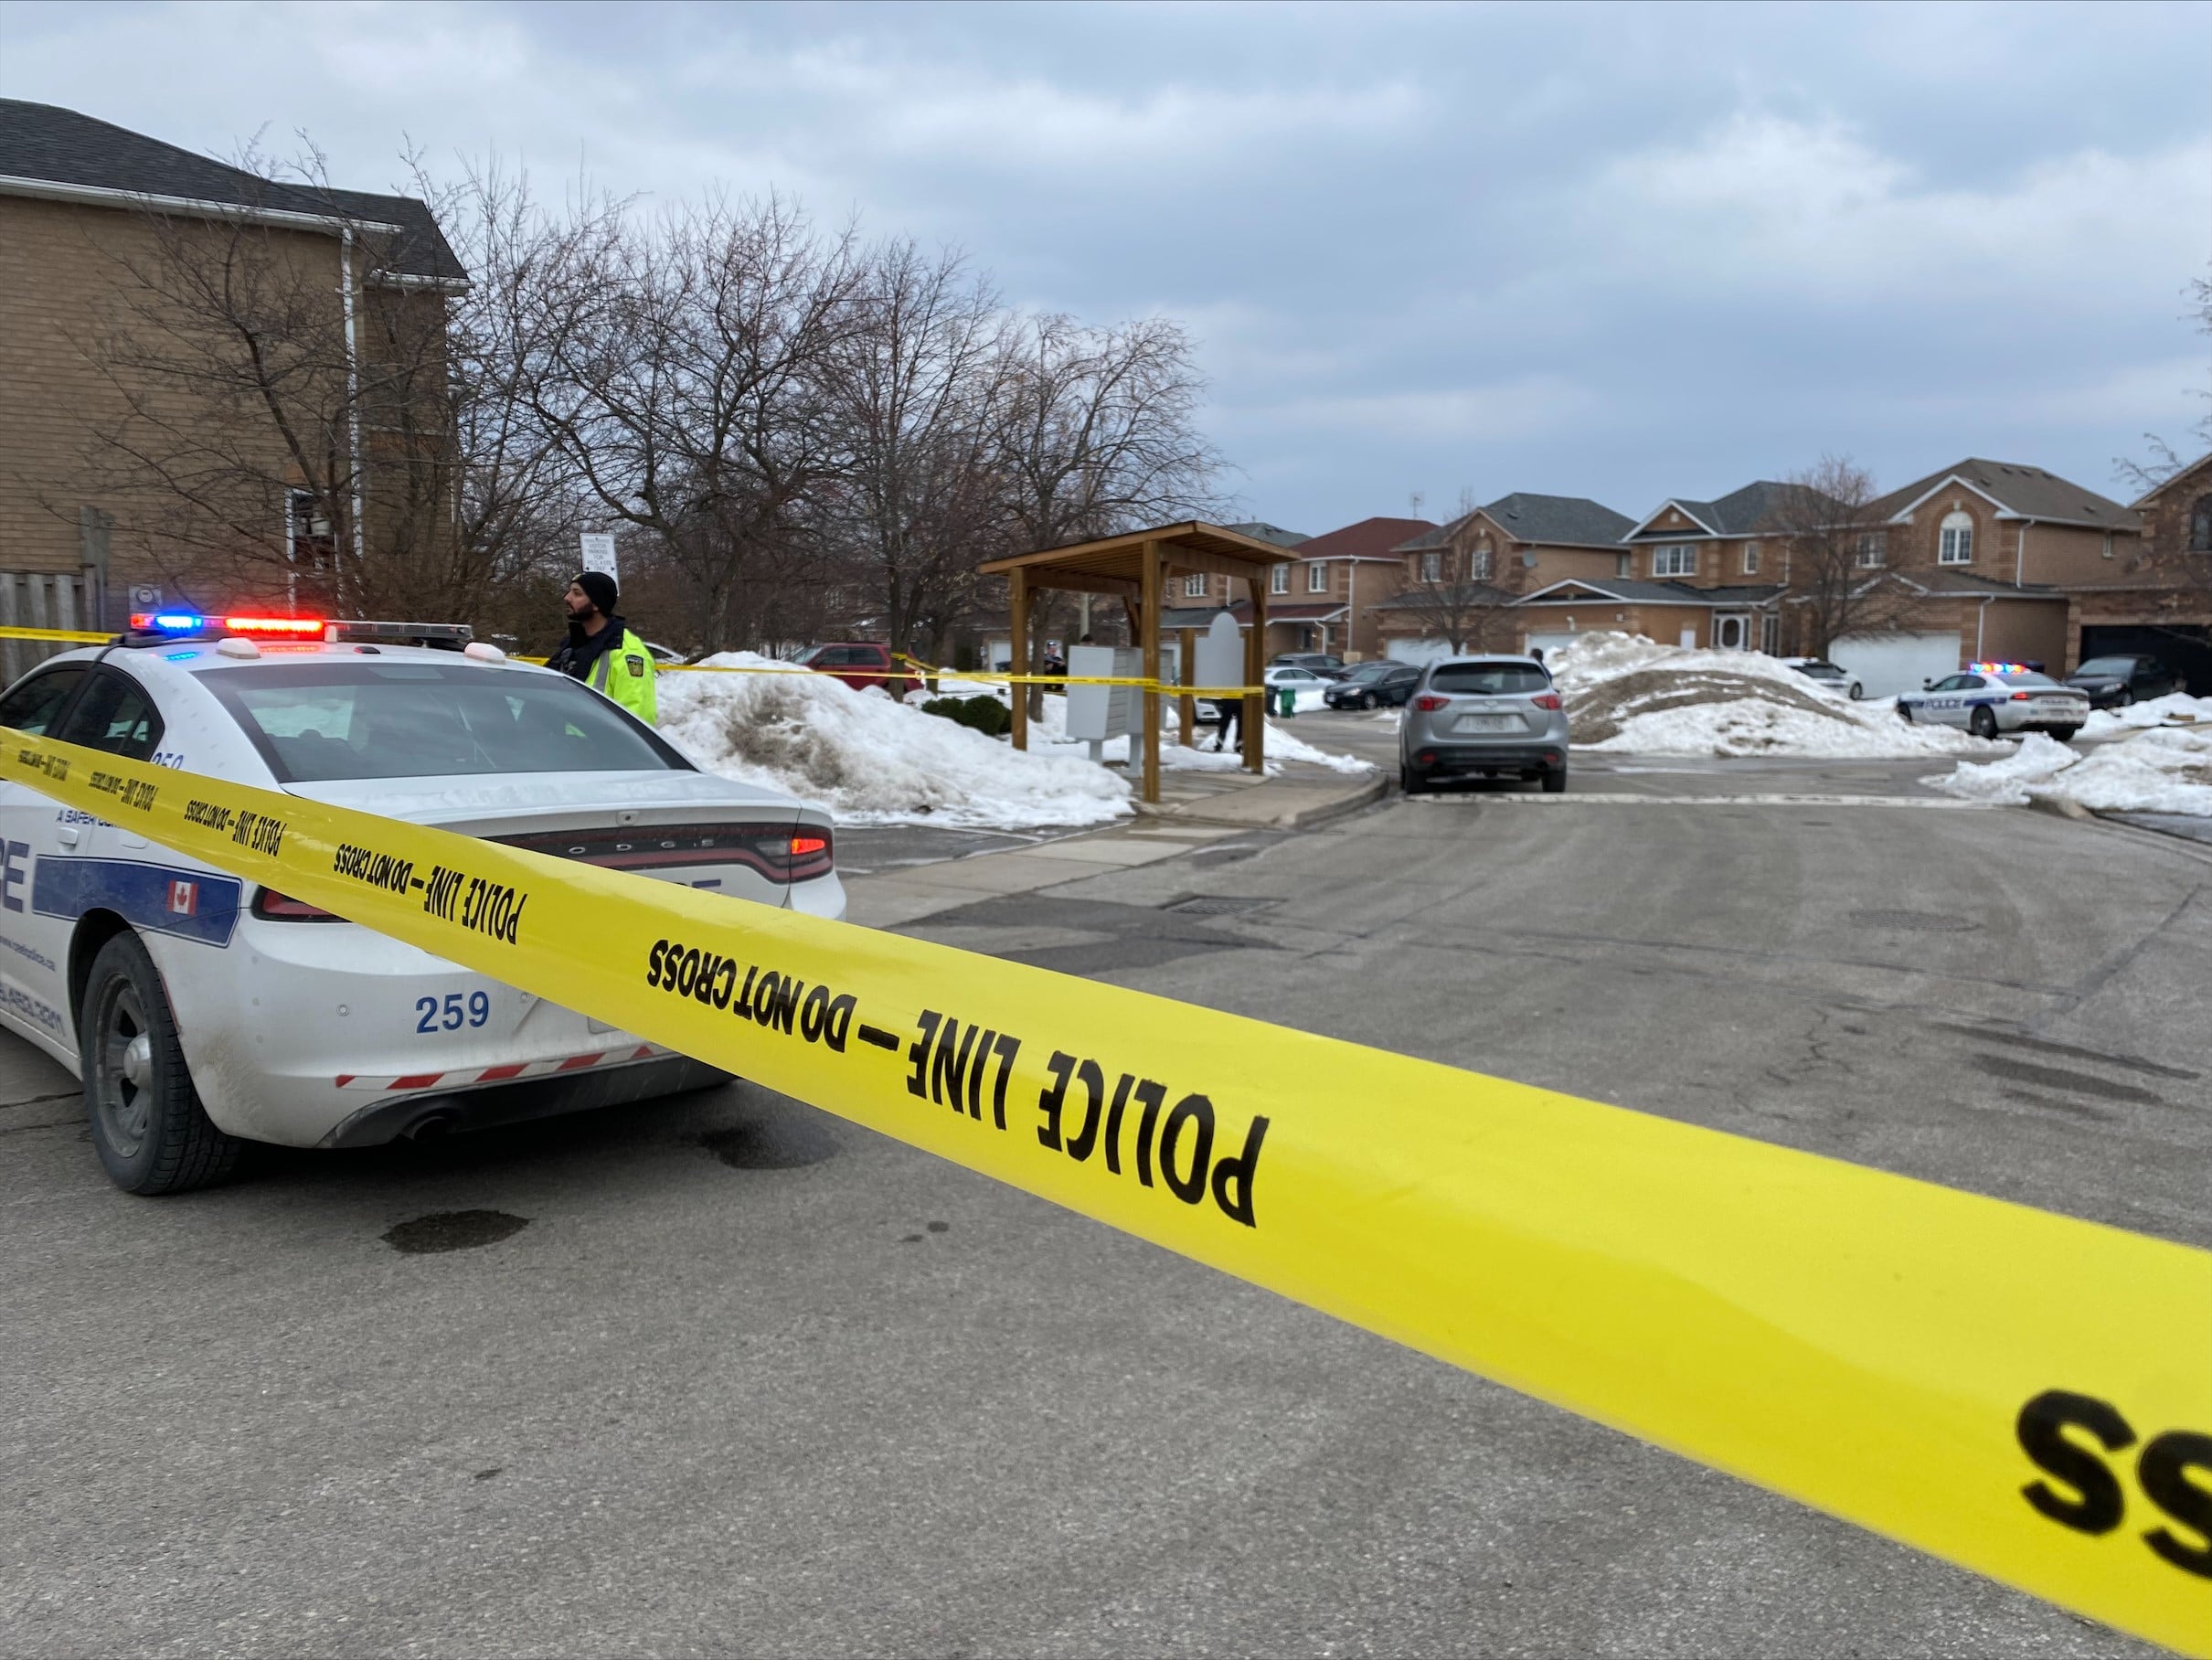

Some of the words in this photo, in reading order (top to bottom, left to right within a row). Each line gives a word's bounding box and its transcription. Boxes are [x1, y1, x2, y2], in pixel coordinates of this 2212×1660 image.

[1924, 696, 1962, 710] POLICE
[424, 865, 465, 922] LINE
[462, 878, 528, 945] POLICE
[415, 990, 489, 1034] 259
[907, 1009, 1022, 1131] LINE
[1037, 1050, 1271, 1229] POLICE
